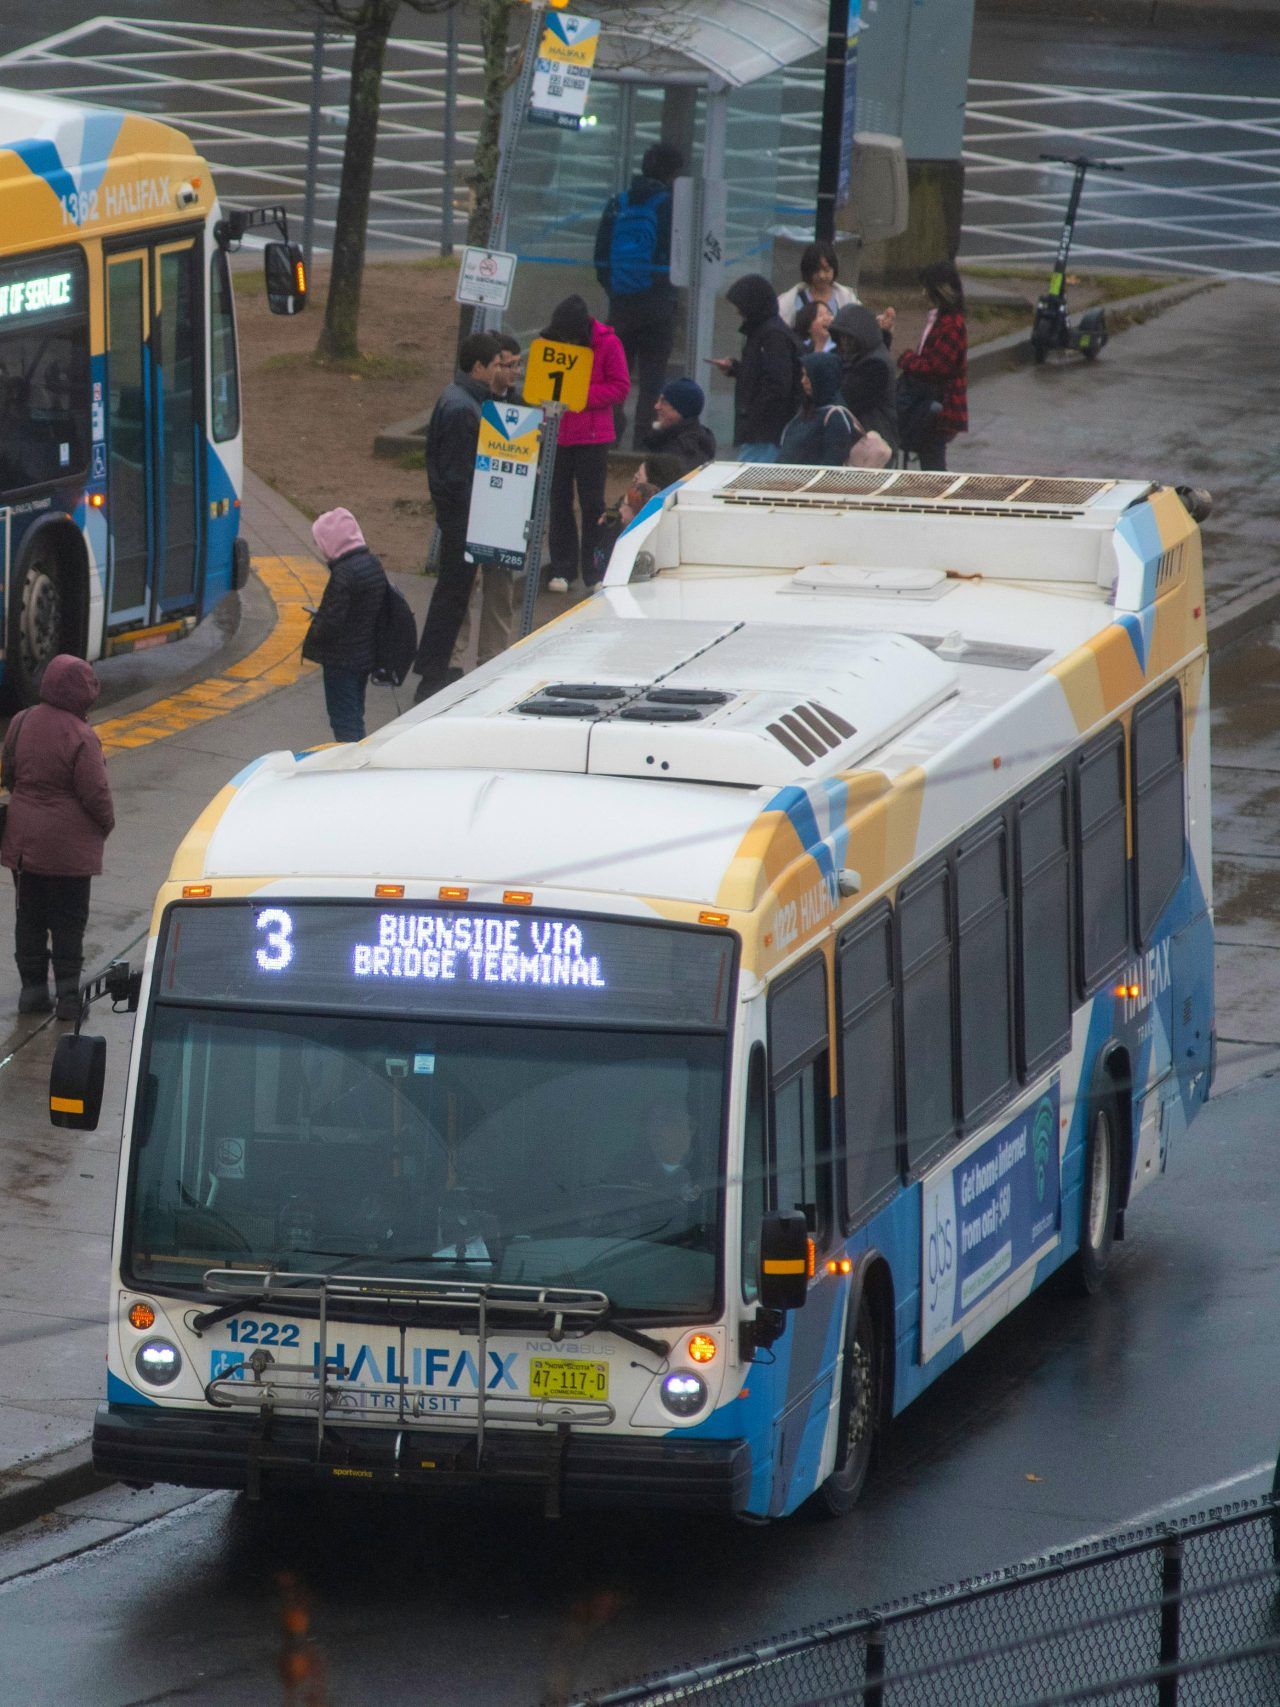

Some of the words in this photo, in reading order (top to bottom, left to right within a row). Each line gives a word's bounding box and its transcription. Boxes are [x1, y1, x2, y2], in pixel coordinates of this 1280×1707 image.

[549, 45, 586, 60] HALIFAX
[61, 189, 100, 226] 1362
[105, 176, 170, 218] HALIFAX
[25, 273, 71, 309] SERVICE
[542, 345, 579, 371] Bay
[548, 371, 565, 401] 1
[488, 440, 530, 456] HALIFAX
[499, 553, 523, 566] 7285
[800, 872, 840, 934] HALIFAX
[256, 908, 294, 970] 3
[379, 914, 521, 953] BURNSIDE
[530, 922, 584, 955] VIA
[354, 944, 457, 979] BRIDGE
[468, 949, 606, 986] TERMINAL
[1123, 936, 1172, 1024] HALIFAX
[961, 1171, 976, 1208] Get
[975, 1156, 999, 1200] home
[998, 1125, 1027, 1178] internet
[961, 1221, 982, 1256] from
[225, 1318, 300, 1348] 1222
[313, 1341, 519, 1390] HALIFAX
[533, 1370, 606, 1391] 47-117-D
[370, 1392, 461, 1412] TRANSIT
[332, 1468, 374, 1478] sportworks
